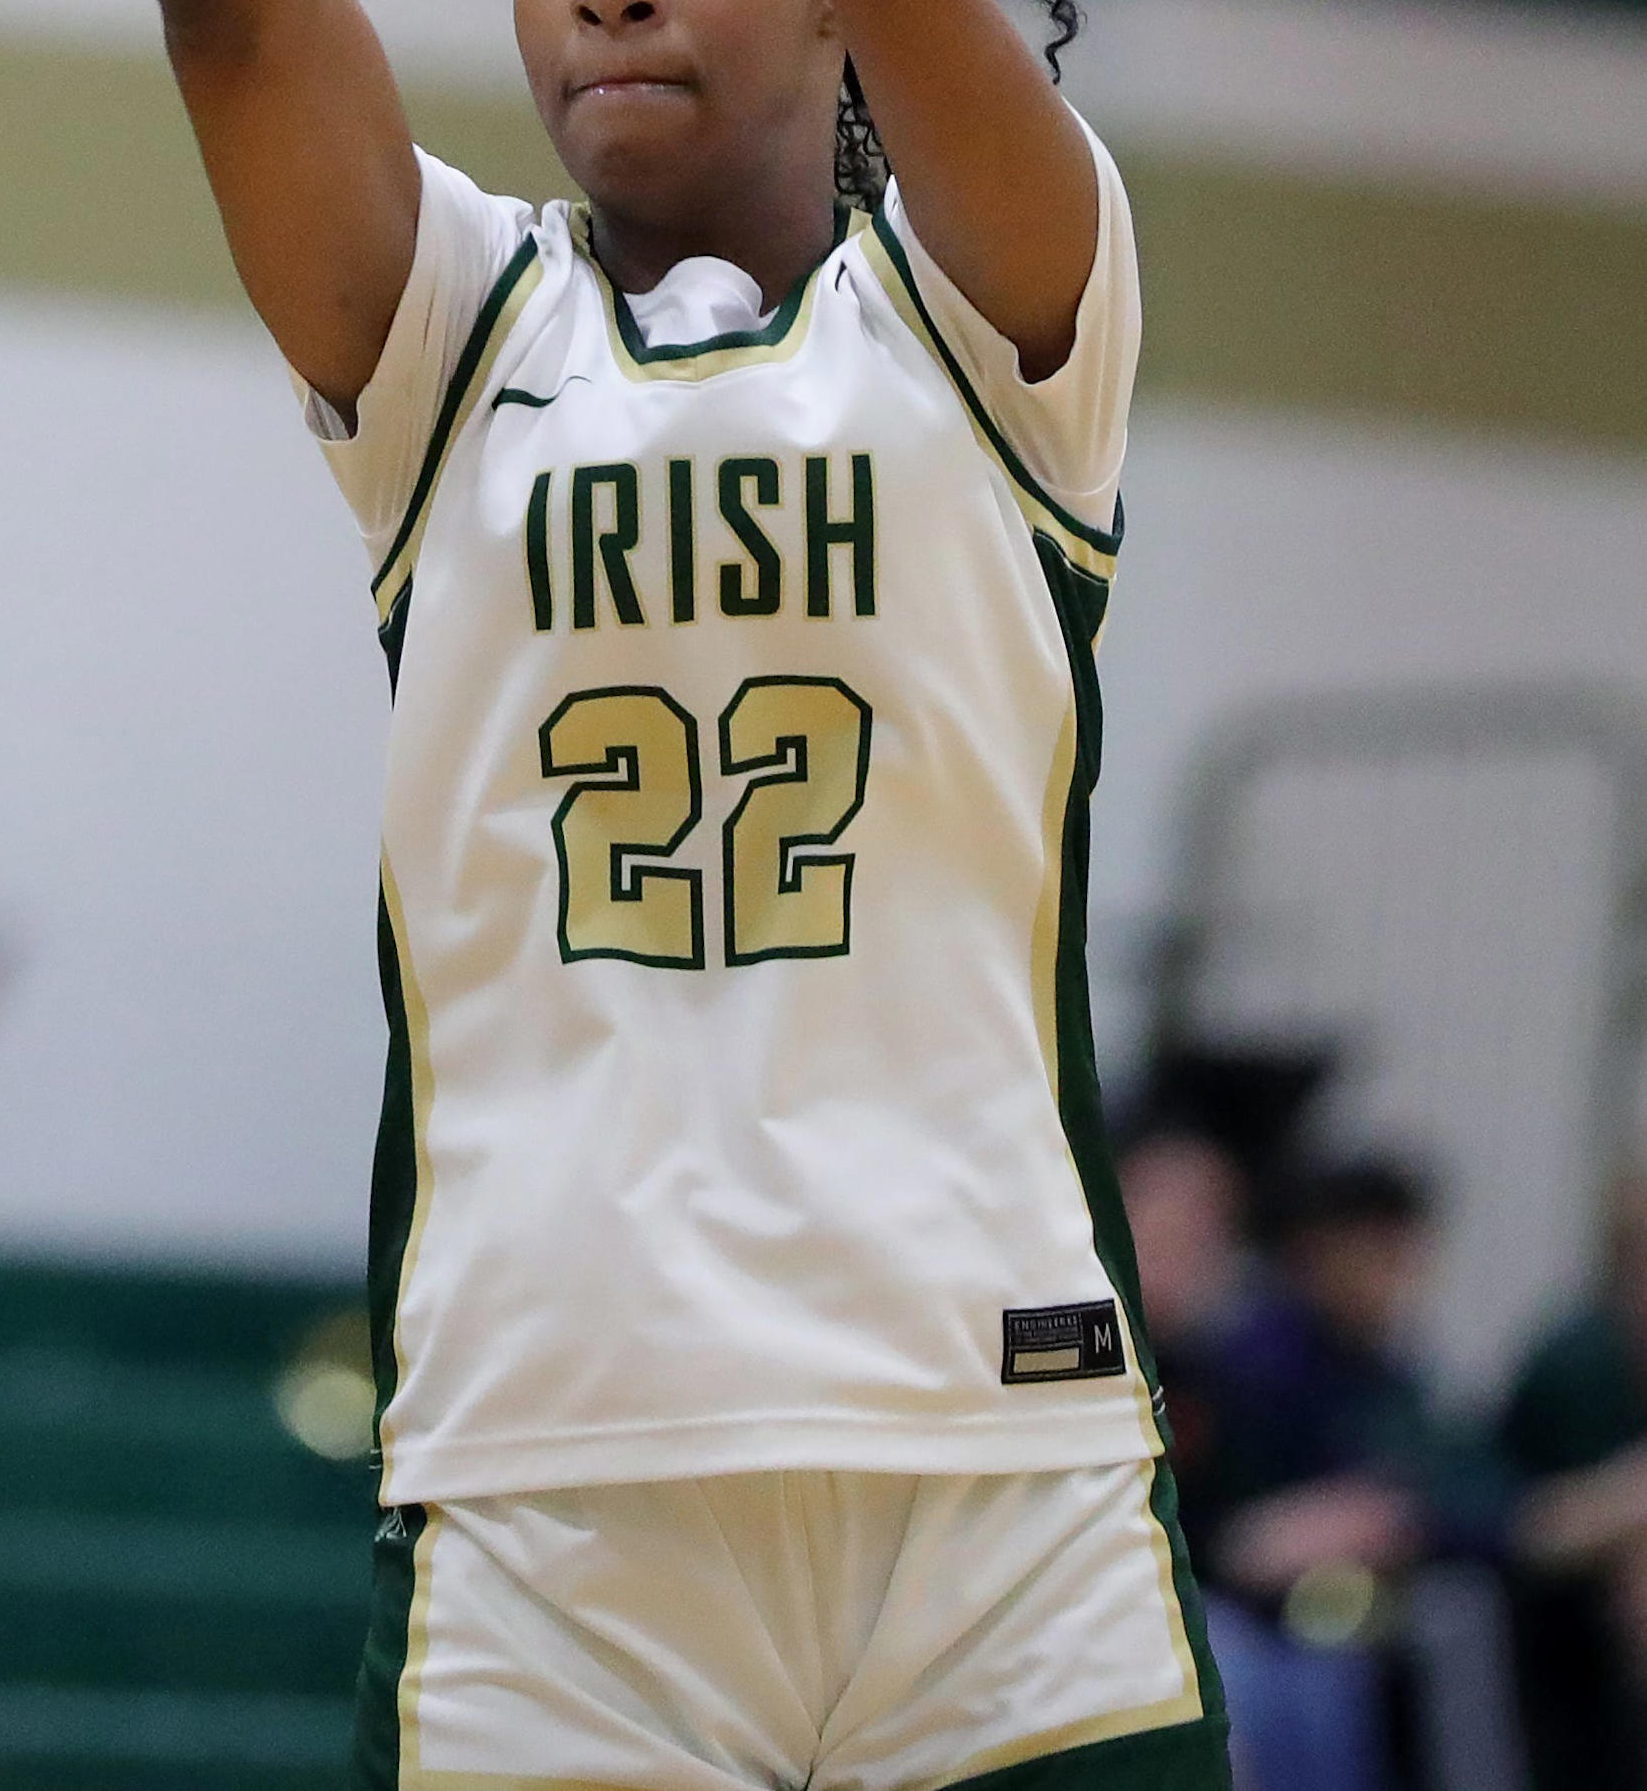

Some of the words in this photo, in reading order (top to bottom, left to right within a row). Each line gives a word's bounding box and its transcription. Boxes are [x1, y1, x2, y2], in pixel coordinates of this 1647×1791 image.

[526, 453, 878, 633] IRISH
[538, 675, 872, 970] 22
[1094, 1322, 1112, 1354] M
